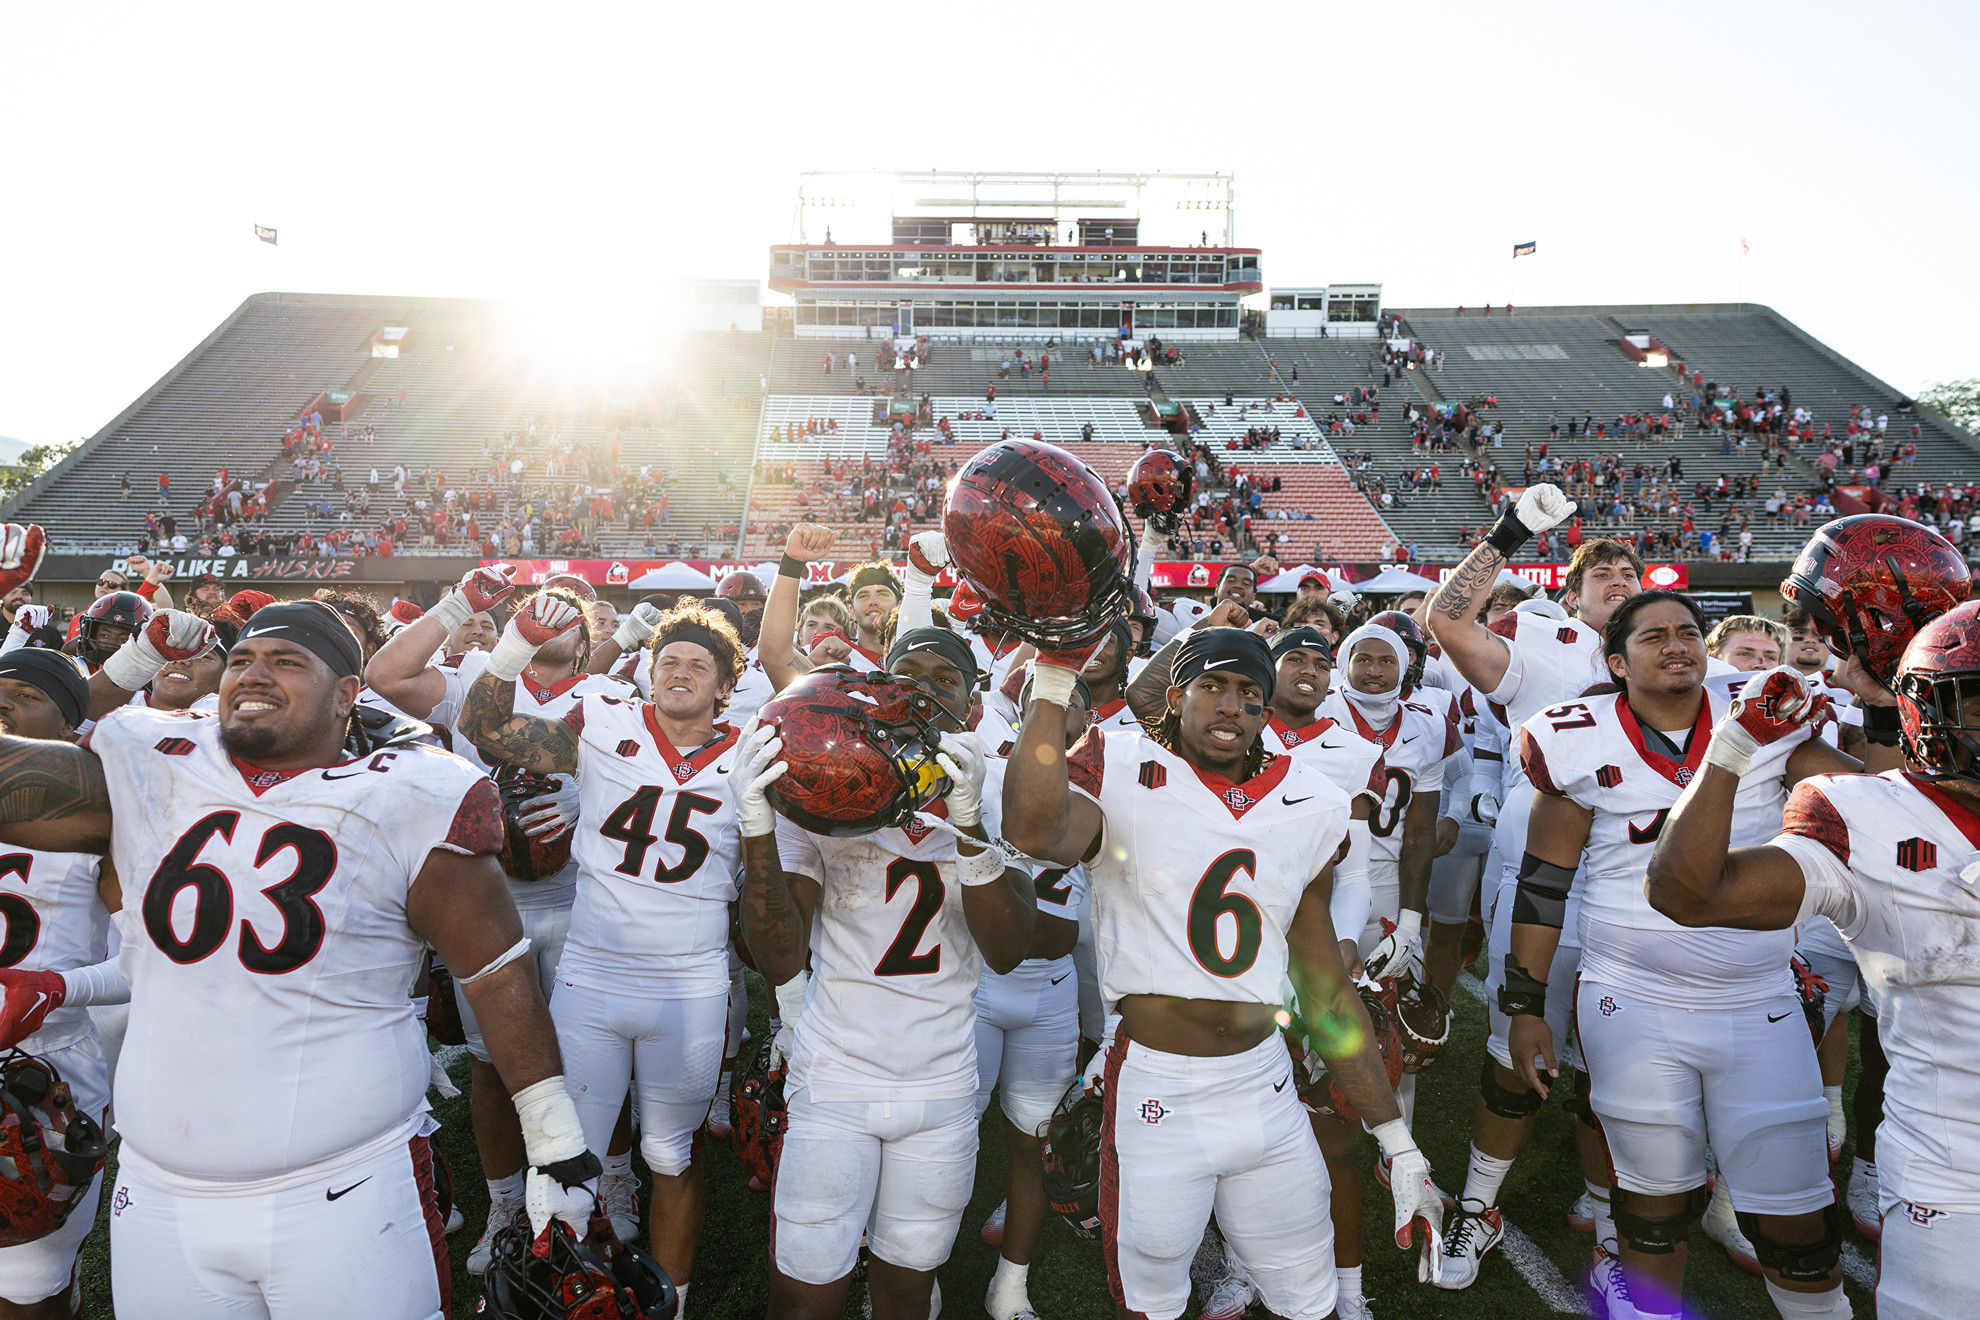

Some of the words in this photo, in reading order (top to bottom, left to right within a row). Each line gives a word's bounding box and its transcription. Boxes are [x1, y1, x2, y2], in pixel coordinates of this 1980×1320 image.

[175, 559, 231, 578] LIKE
[231, 559, 248, 578] A
[252, 558, 355, 579] HUSKIE
[550, 560, 569, 572] NIU
[1544, 700, 1598, 733] 57
[367, 752, 398, 773] C
[599, 784, 722, 884] 45
[142, 809, 337, 974] 63
[873, 856, 945, 976] 2
[1187, 848, 1262, 978] 6
